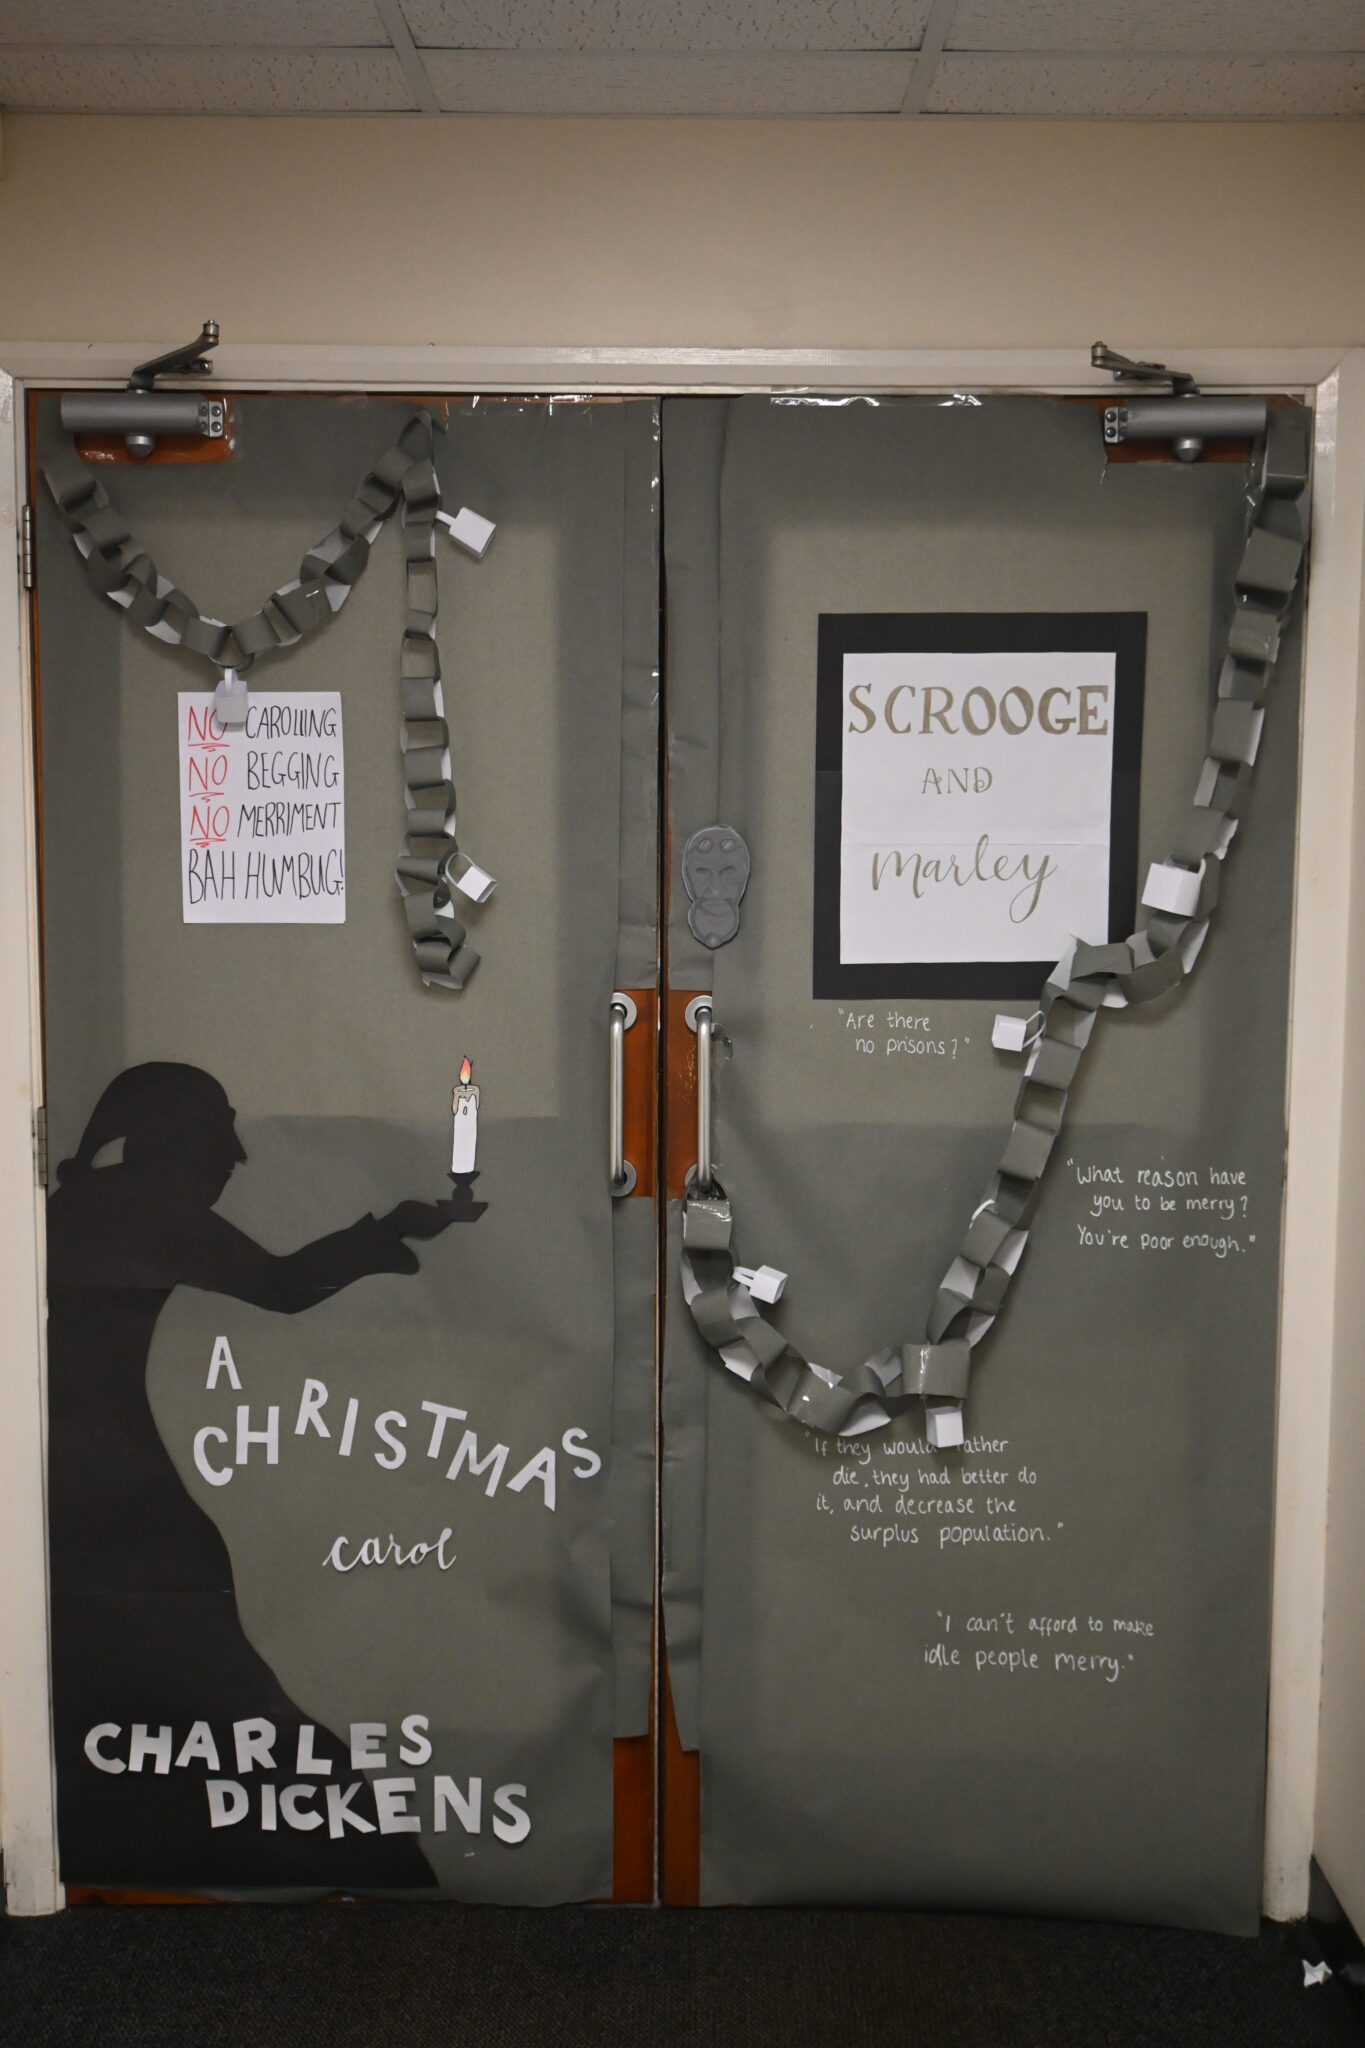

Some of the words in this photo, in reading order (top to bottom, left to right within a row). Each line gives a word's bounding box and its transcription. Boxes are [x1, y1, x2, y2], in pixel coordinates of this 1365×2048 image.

[246, 705, 337, 739] CAROLLING
[849, 682, 1109, 736] SCROOGE
[189, 754, 228, 791] NO
[247, 751, 339, 789] BEGGING
[921, 766, 994, 794] AND
[190, 805, 230, 839] NO
[237, 802, 342, 838] MERRIMENT
[188, 848, 235, 904] BAH
[245, 848, 344, 900] HUMBUG!
[886, 1011, 931, 1032] there
[855, 1038, 875, 1054] no
[1137, 1168, 1199, 1188] reason
[1209, 1167, 1247, 1185] have
[1089, 1195, 1125, 1217] you
[1134, 1195, 1151, 1211] to
[1160, 1196, 1177, 1211] be
[1077, 1224, 1130, 1249] You're
[1140, 1233, 1175, 1250] poor
[206, 1336, 242, 1390] A
[193, 1378, 602, 1512] CHRISTMAS
[836, 1437, 871, 1465] they
[957, 1435, 1009, 1454] ather
[872, 1469, 910, 1492] they
[918, 1466, 951, 1485] had
[961, 1467, 1009, 1485] better
[1018, 1466, 1037, 1485] do
[843, 1494, 884, 1513] and
[895, 1494, 975, 1515] decrease
[986, 1497, 1017, 1513] the
[322, 1527, 457, 1572] carol
[850, 1523, 919, 1548] surplus
[966, 1612, 1015, 1634] can't
[1028, 1616, 1078, 1637] afford
[1088, 1616, 1104, 1632] to
[1113, 1619, 1155, 1637] make
[924, 1643, 961, 1671] idle
[975, 1648, 1040, 1673] people
[84, 1714, 433, 1775] CHARLES
[205, 1775, 532, 1844] DICKENS
